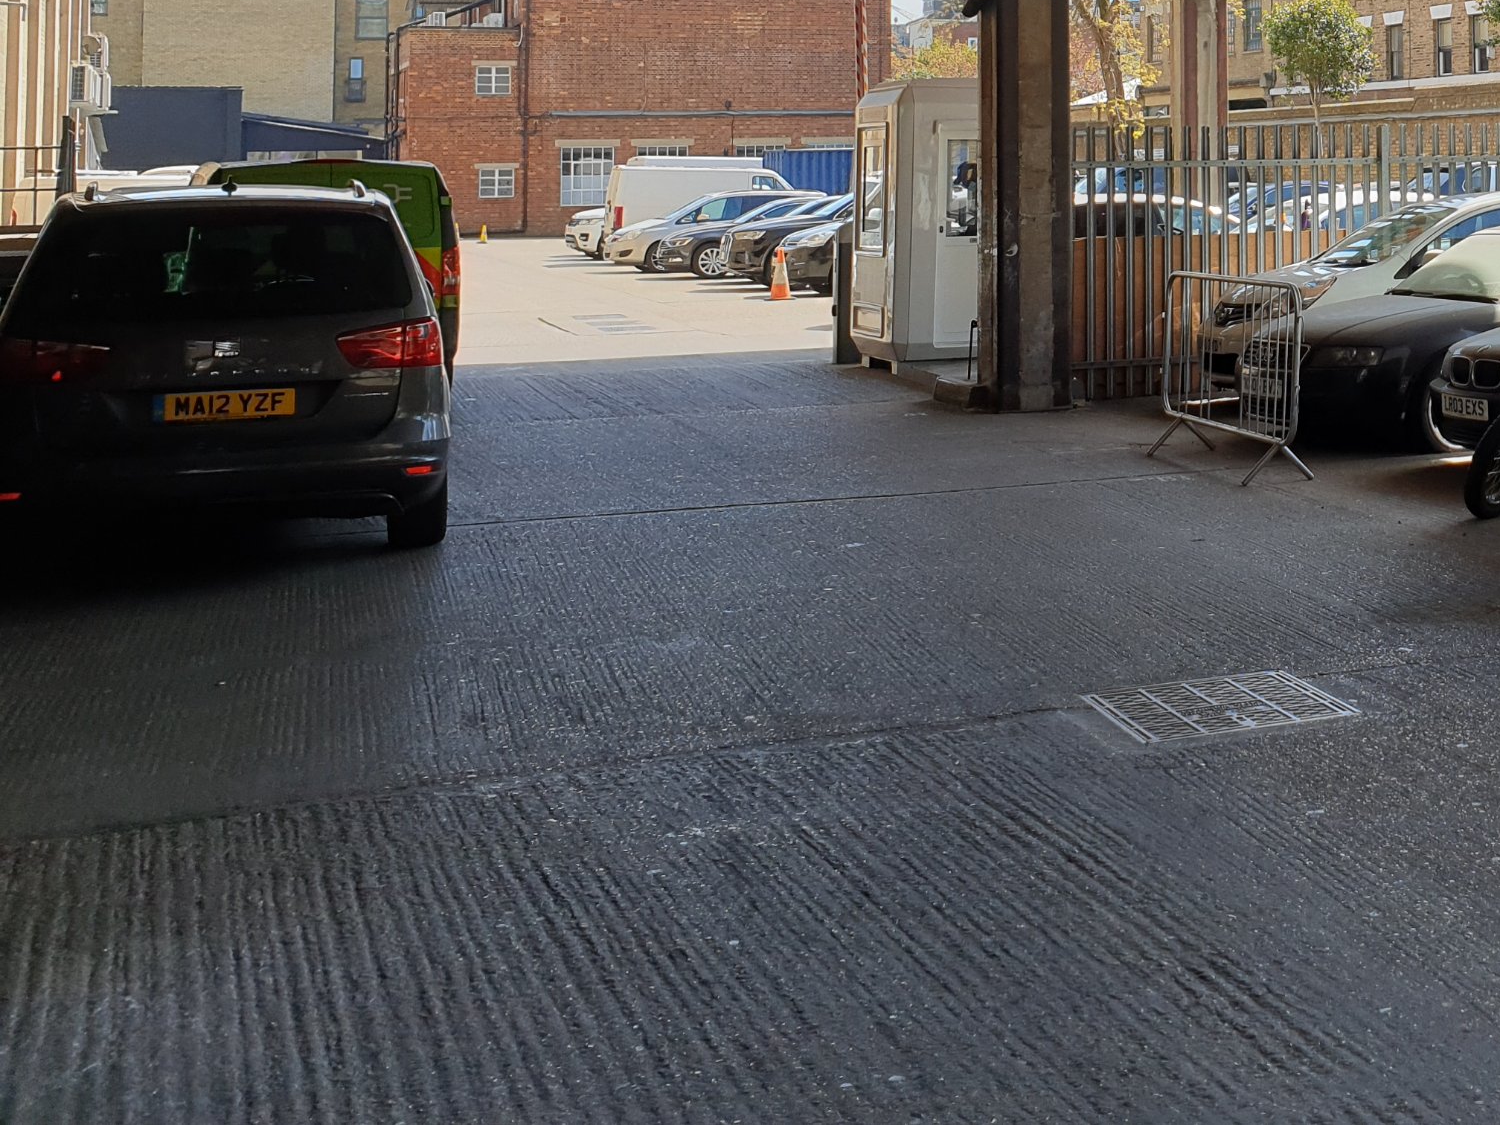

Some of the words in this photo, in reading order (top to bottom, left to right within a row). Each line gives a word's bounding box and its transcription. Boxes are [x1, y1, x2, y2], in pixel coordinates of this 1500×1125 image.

[174, 395, 231, 416] MA12
[238, 392, 286, 413] YZF
[1465, 399, 1485, 417] EXS
